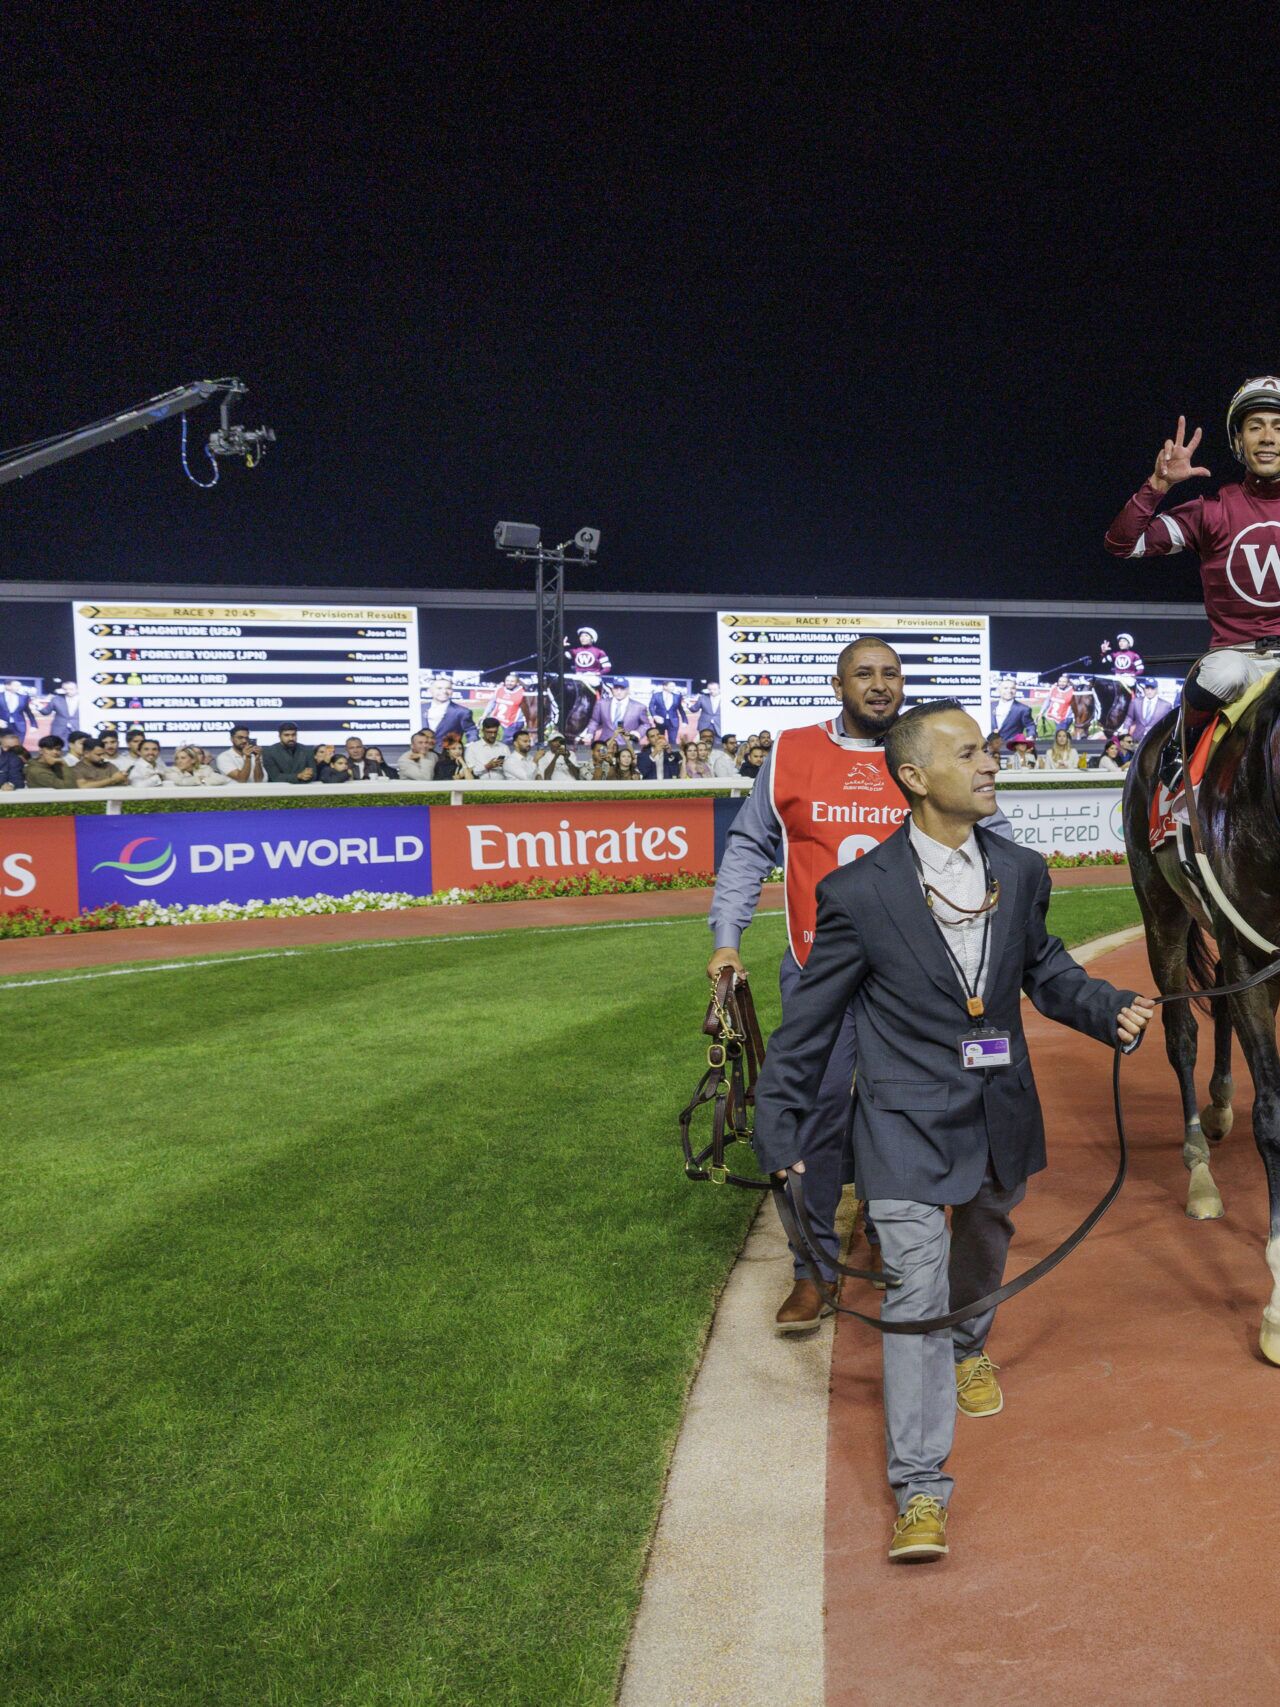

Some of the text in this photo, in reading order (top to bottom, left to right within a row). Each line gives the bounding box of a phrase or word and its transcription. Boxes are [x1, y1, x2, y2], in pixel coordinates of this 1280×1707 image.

[173, 608, 204, 617] RACE
[208, 608, 214, 617] 9
[302, 610, 407, 620] Provisional Results
[796, 617, 820, 625] RACE
[948, 619, 981, 627] Results
[112, 625, 122, 635] 2
[139, 625, 208, 636] MAGNITUDE
[209, 626, 242, 637] (USA)
[748, 633, 755, 641] 6
[769, 633, 834, 642] TUMBARUMBA
[114, 650, 122, 659] 1
[141, 650, 194, 660] FOREVER
[195, 651, 234, 660] YOUNG
[236, 651, 267, 661] (JPN)
[769, 655, 801, 663] HEART
[801, 655, 815, 663] OF
[114, 674, 124, 683] 4
[141, 674, 199, 684] MEYDAAN
[200, 674, 228, 684] (IRE)
[771, 676, 788, 684] TAP
[789, 676, 826, 684] LEADER
[143, 698, 198, 708] IMPERIAL
[199, 698, 254, 708] EMPEROR
[256, 698, 283, 708] (IRE)
[771, 697, 799, 705] WALK
[799, 697, 812, 705] OF
[117, 722, 127, 731] 3
[144, 722, 164, 731] HIT
[166, 722, 201, 731] SHOW
[202, 722, 235, 732] (USA)
[1029, 802, 1100, 821] زعبيل
[466, 819, 689, 872] Emirates
[189, 835, 424, 873] DP WORLD
